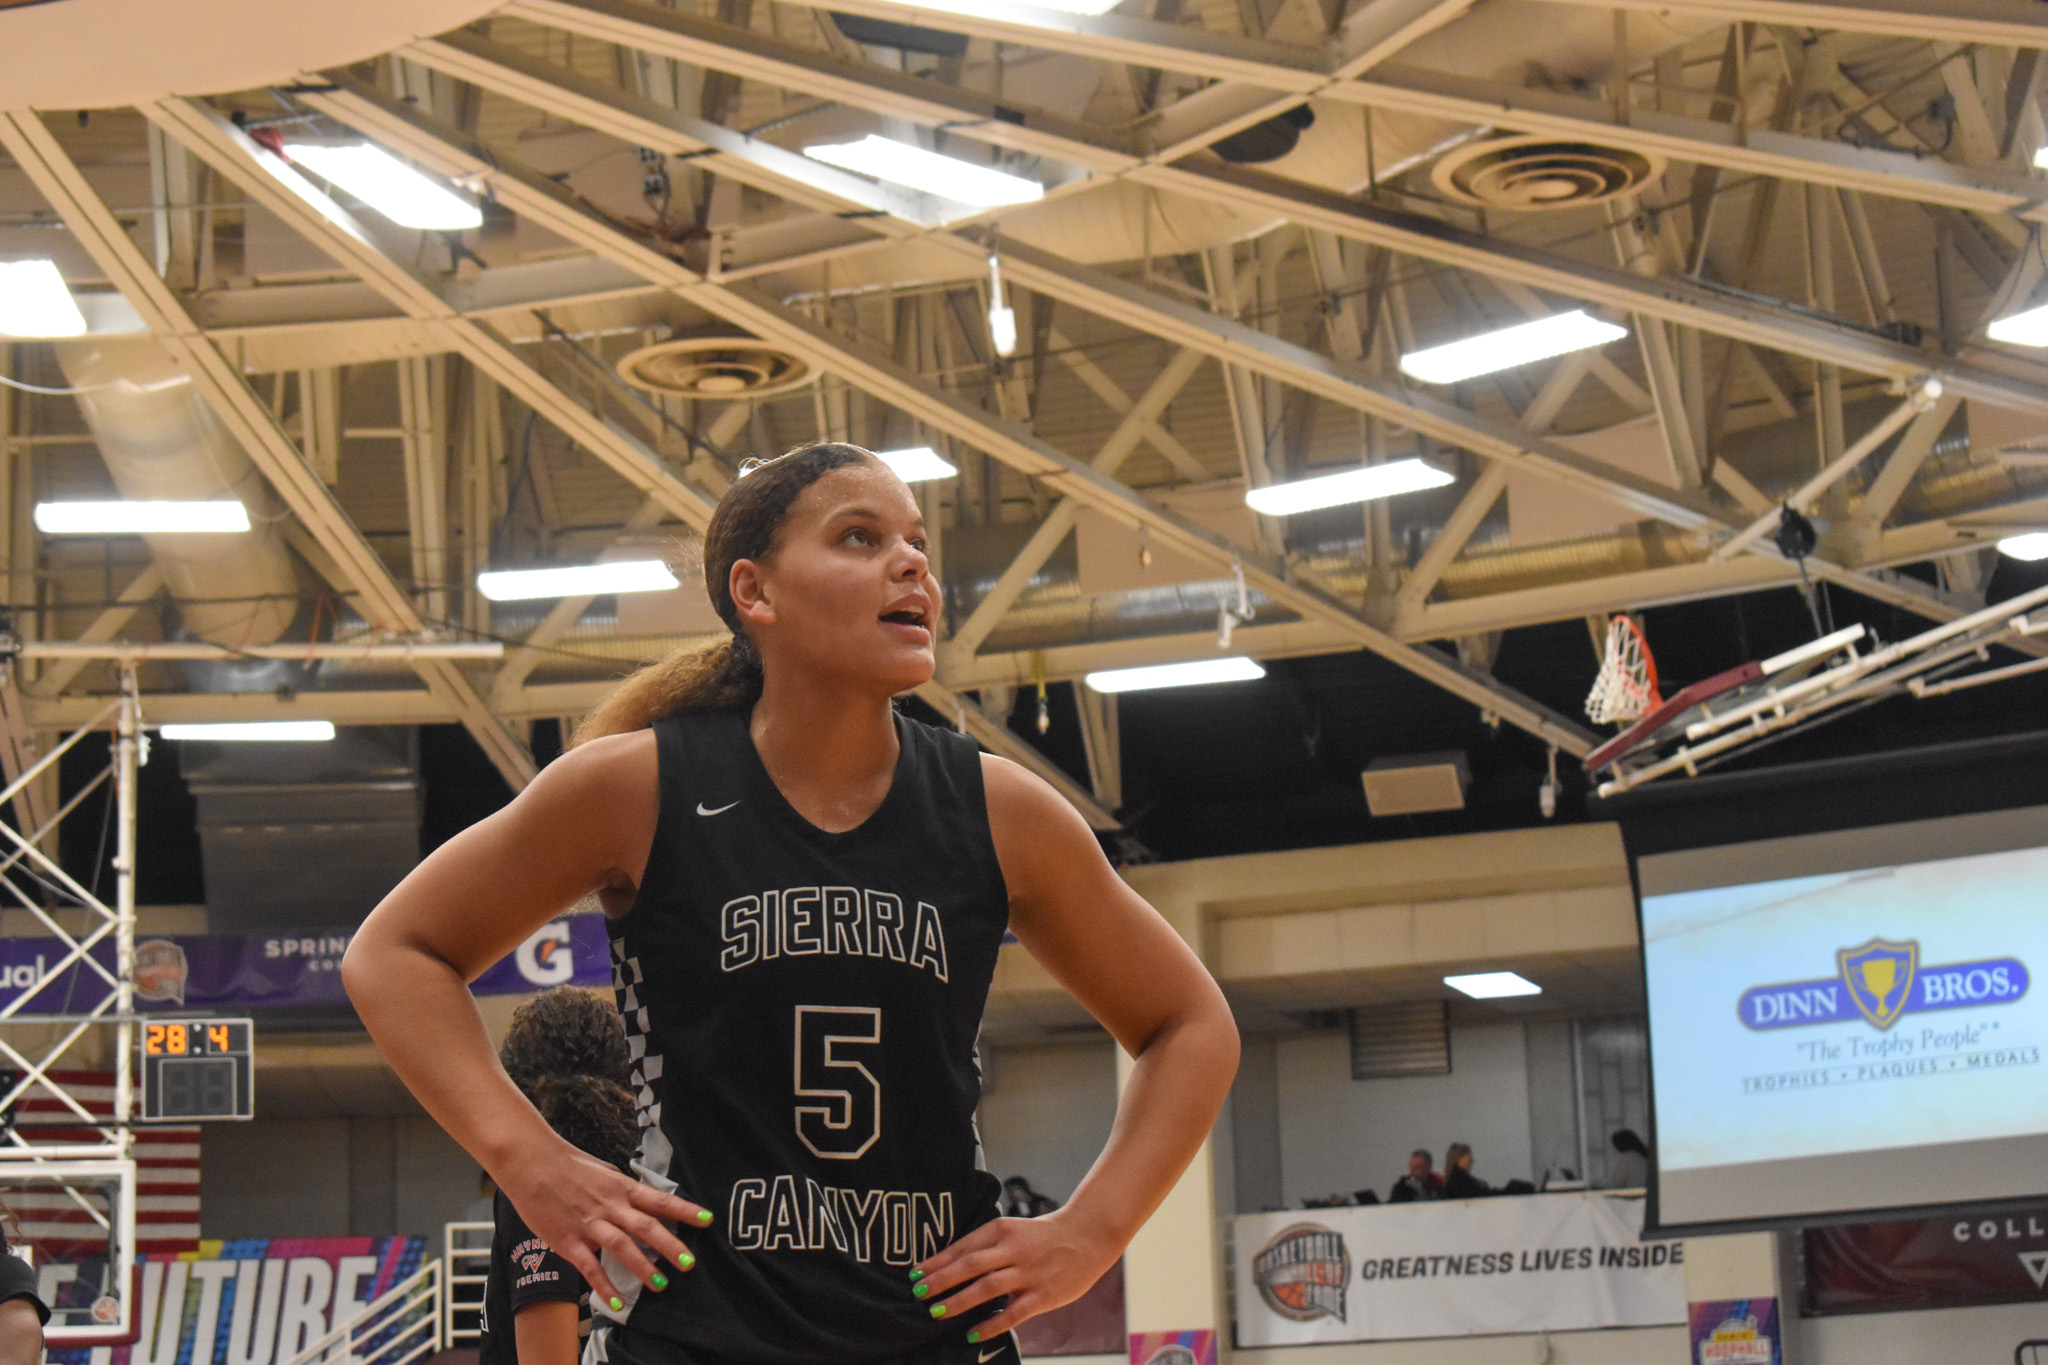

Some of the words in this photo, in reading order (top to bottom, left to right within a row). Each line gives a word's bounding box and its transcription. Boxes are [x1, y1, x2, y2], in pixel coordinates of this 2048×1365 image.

[264, 936, 352, 958] SPRIN
[515, 920, 574, 986] G
[721, 886, 948, 983] SIERRA
[1753, 986, 1839, 1024] DINN
[1921, 965, 2020, 1005] BROS.
[1849, 1031, 1914, 1058] Trophy
[795, 1005, 881, 1160] 5
[1742, 1070, 1831, 1093] TROPHIES
[1858, 1058, 1939, 1080] PLAQUES
[1967, 1048, 2041, 1068] MEDALS
[728, 1174, 955, 1266] CANYON
[1953, 1217, 2045, 1243] COLL
[511, 1238, 555, 1263] WHYNO
[1362, 1252, 1514, 1281] GREATNESS
[1520, 1246, 1592, 1272] LIVES
[1598, 1242, 1684, 1268] INSIDE
[516, 1271, 560, 1289] PREMIER
